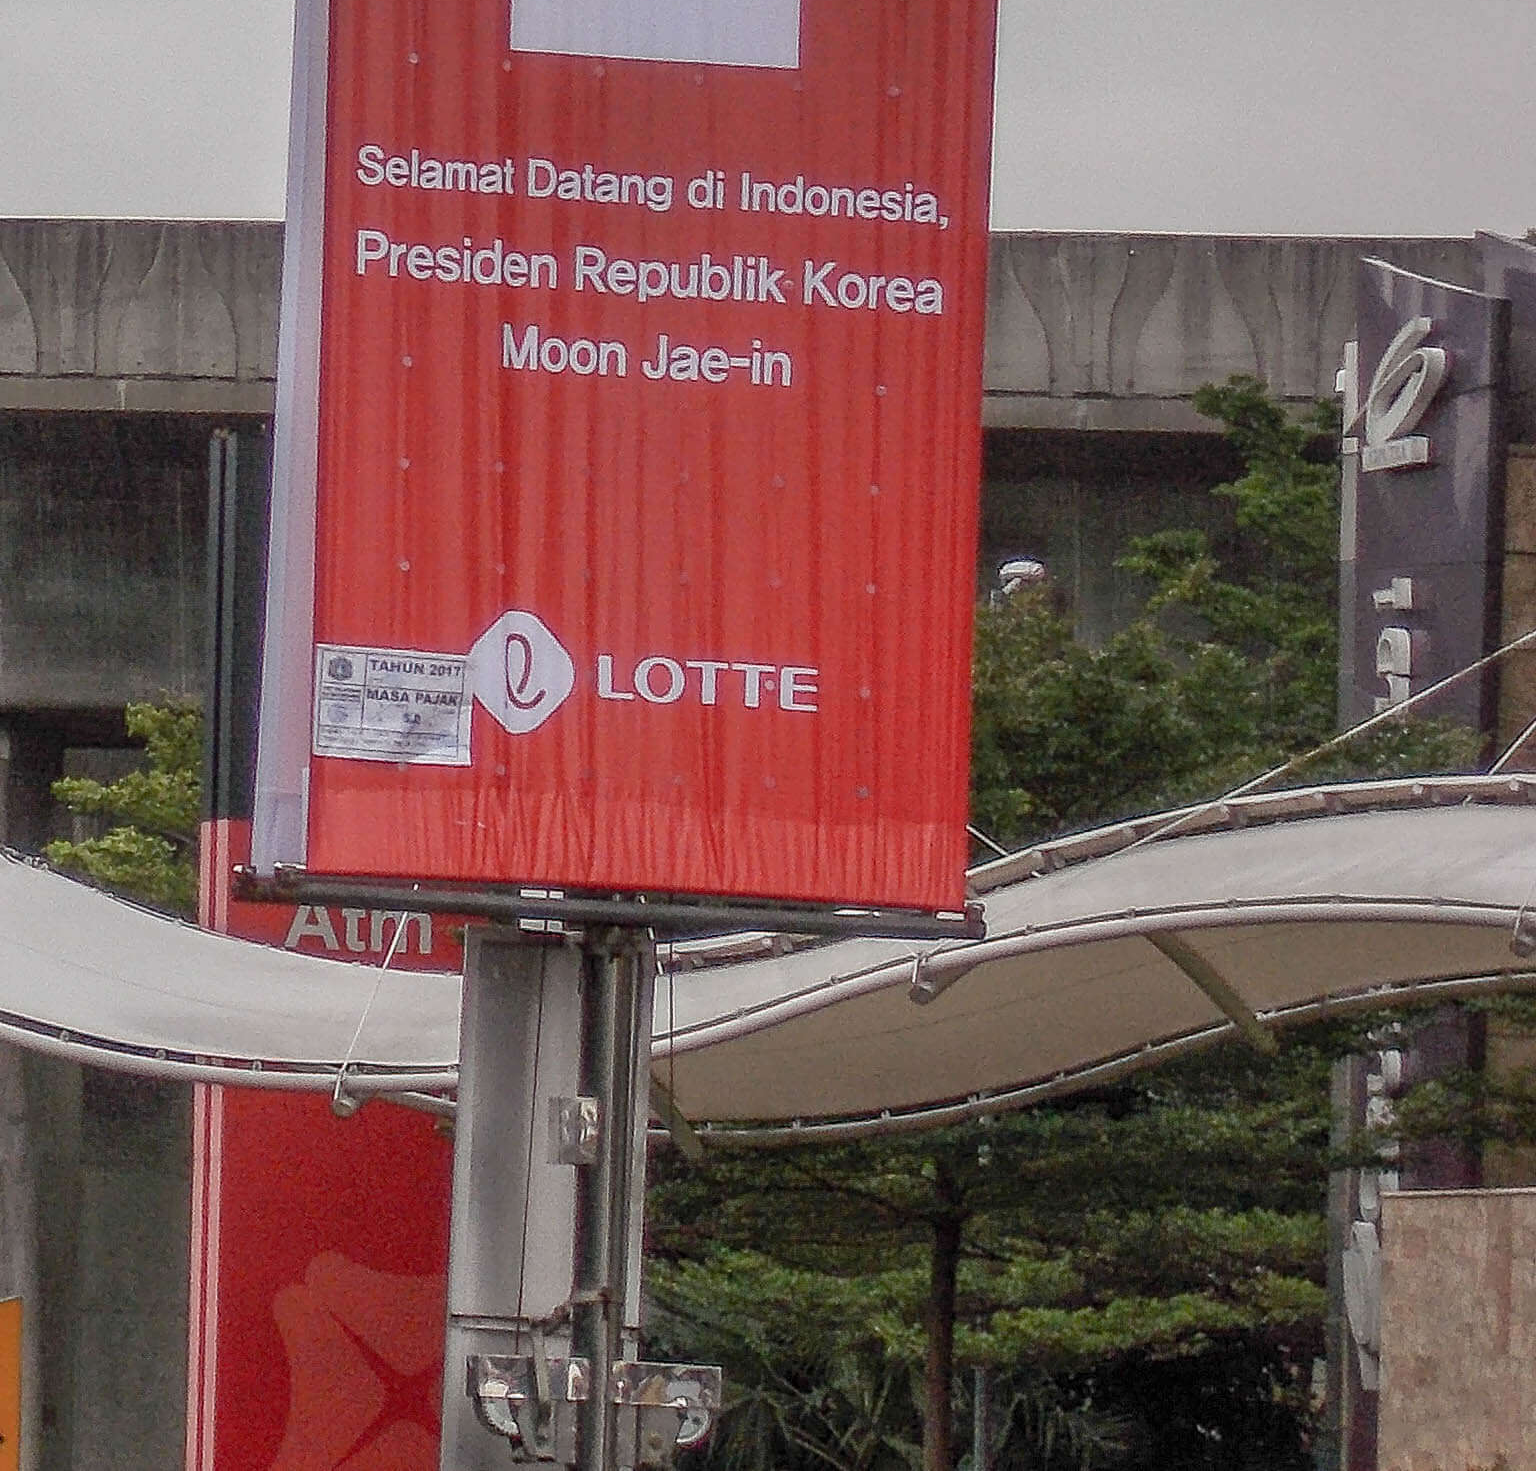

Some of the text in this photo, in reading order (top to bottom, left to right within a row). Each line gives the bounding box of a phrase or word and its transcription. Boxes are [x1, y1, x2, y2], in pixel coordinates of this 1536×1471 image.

[356, 145, 950, 230] Selamat Datang di Indonesia,
[356, 230, 944, 315] Presiden Republik Korea
[502, 325, 793, 386] Moon Jae-in
[367, 689, 409, 702] MASA
[369, 659, 461, 677] TAHUN 2017
[598, 655, 819, 711] LOTTE
[285, 905, 432, 954] Atm
